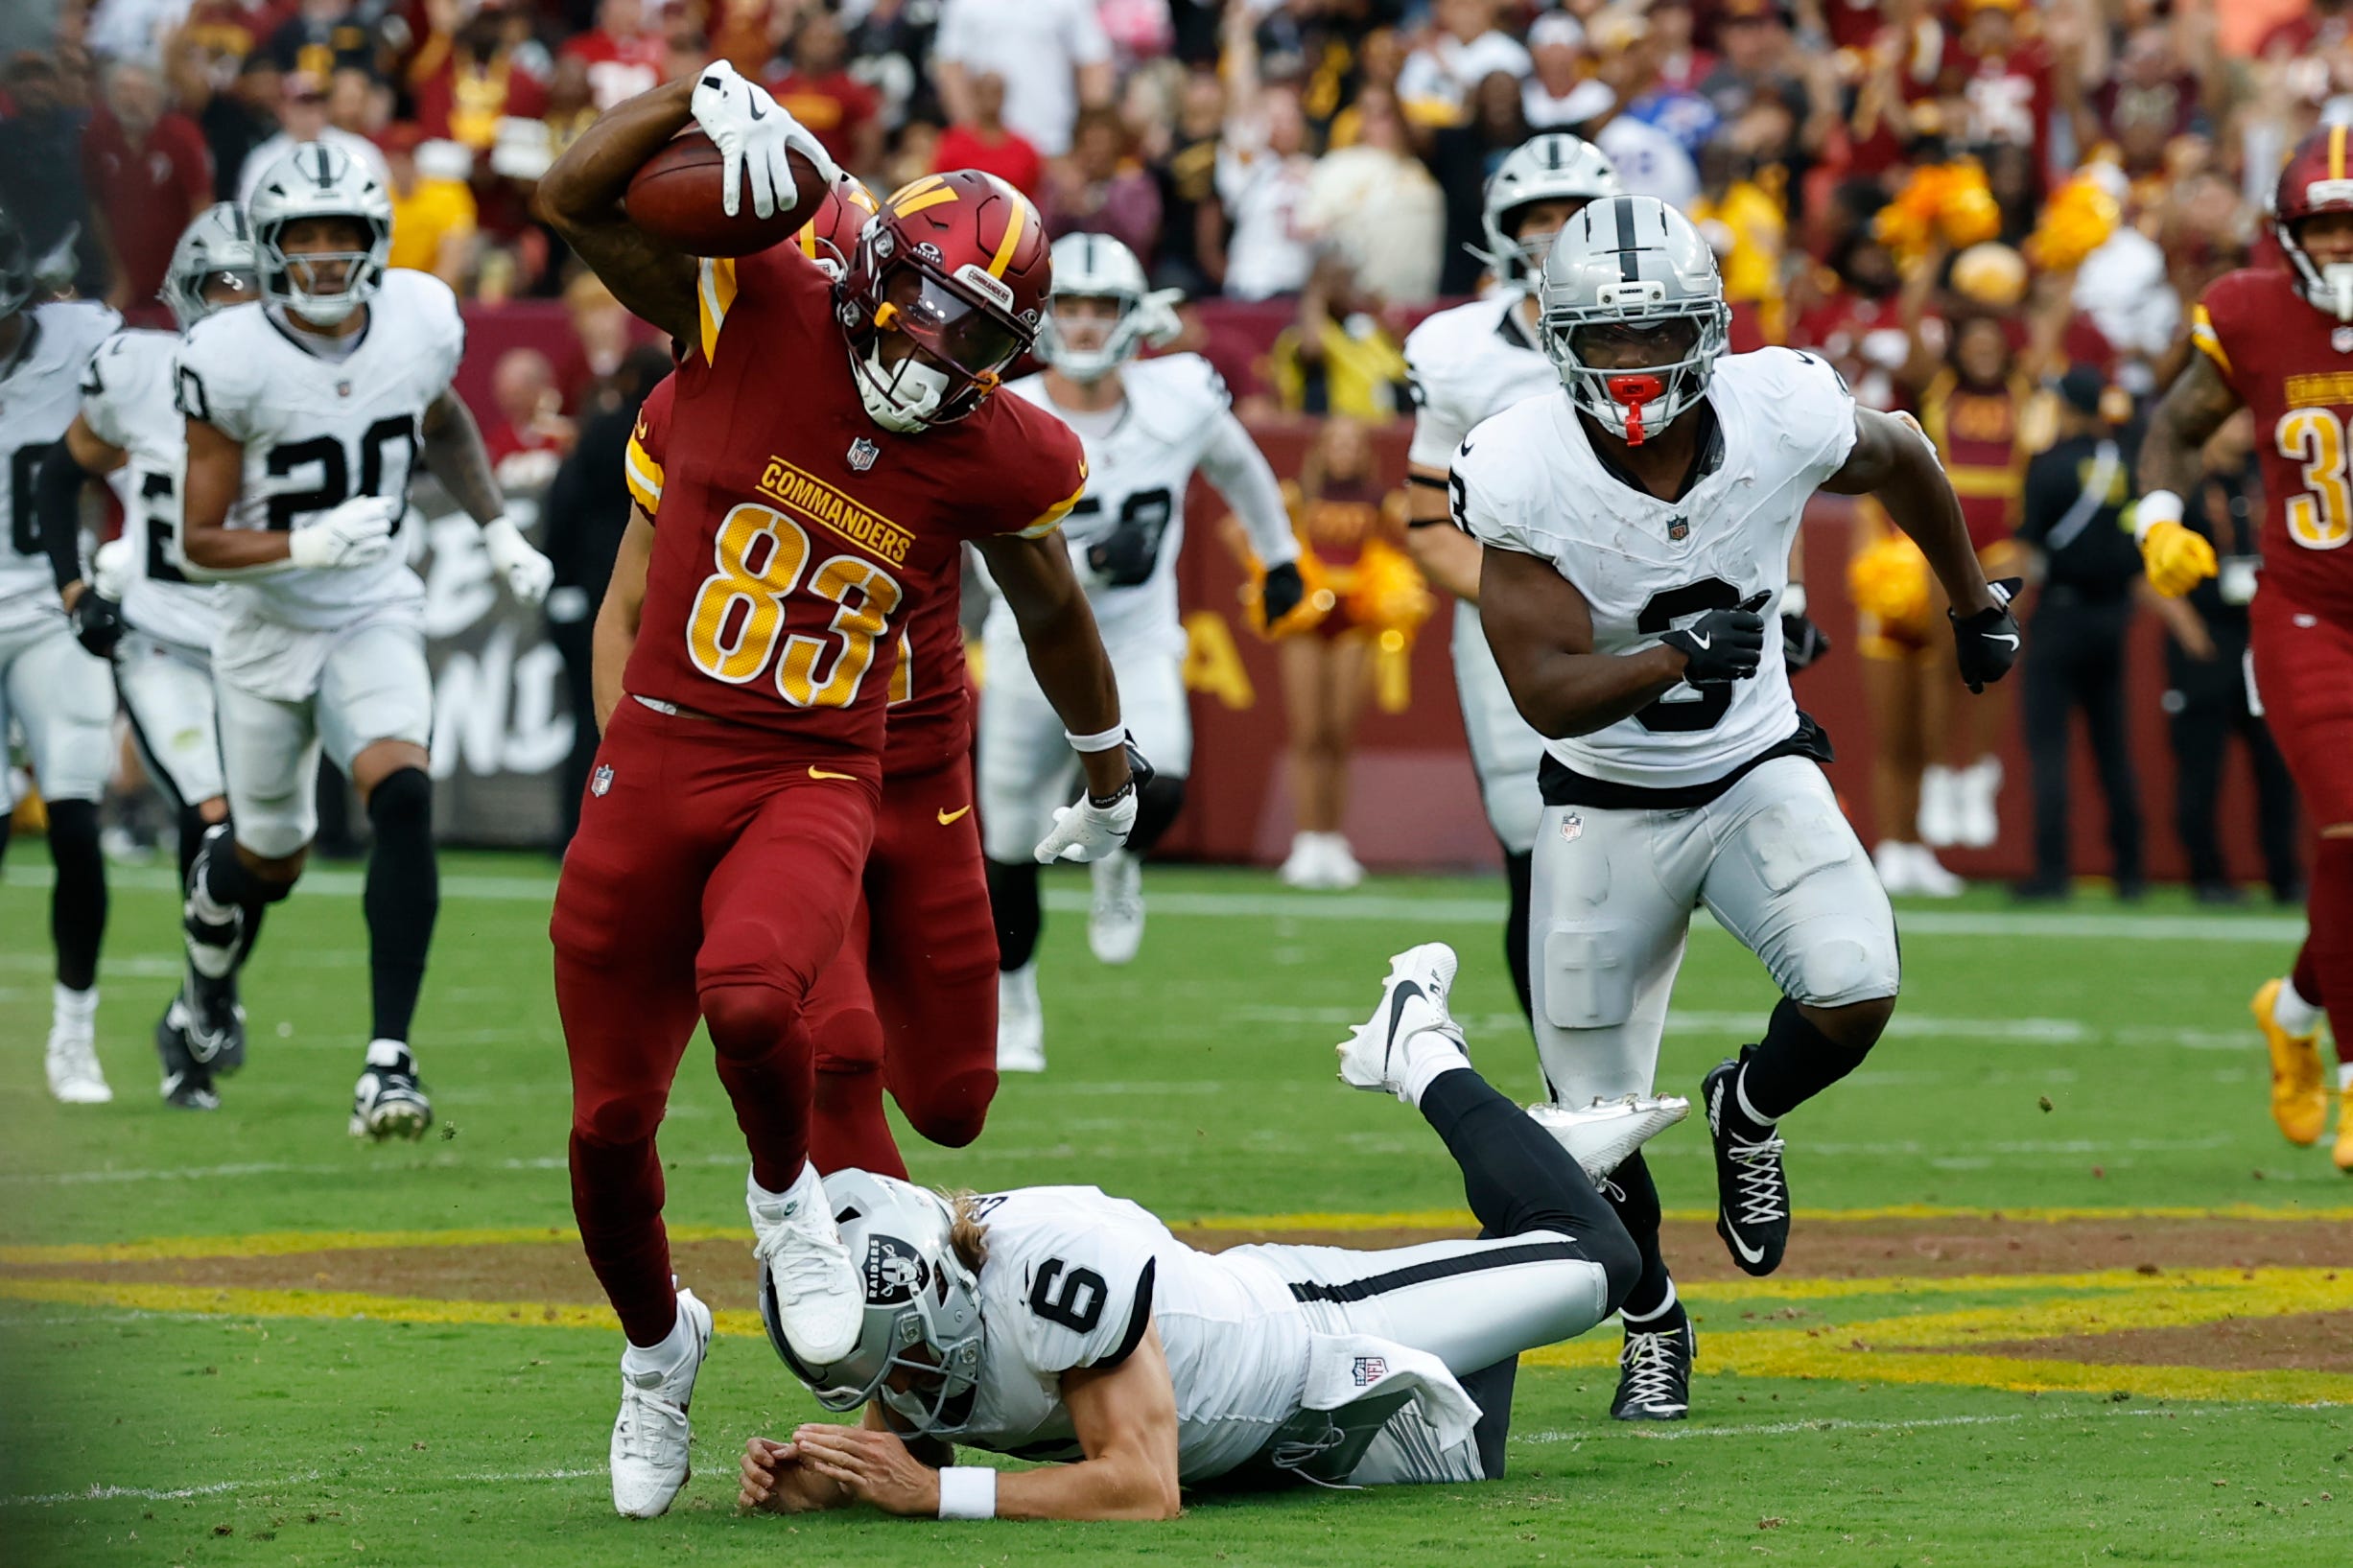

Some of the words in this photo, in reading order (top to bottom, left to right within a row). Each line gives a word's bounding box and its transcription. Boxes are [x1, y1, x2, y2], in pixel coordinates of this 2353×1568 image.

[968, 269, 1009, 301] COMMANDERS
[267, 414, 416, 537] 20
[762, 463, 910, 562] COMMANDERS
[2275, 408, 2353, 550] 3
[687, 503, 903, 708] 83
[869, 1239, 880, 1298] RAIDERS
[1028, 1255, 1109, 1335] 6
[1367, 1361, 1383, 1382] NFL
